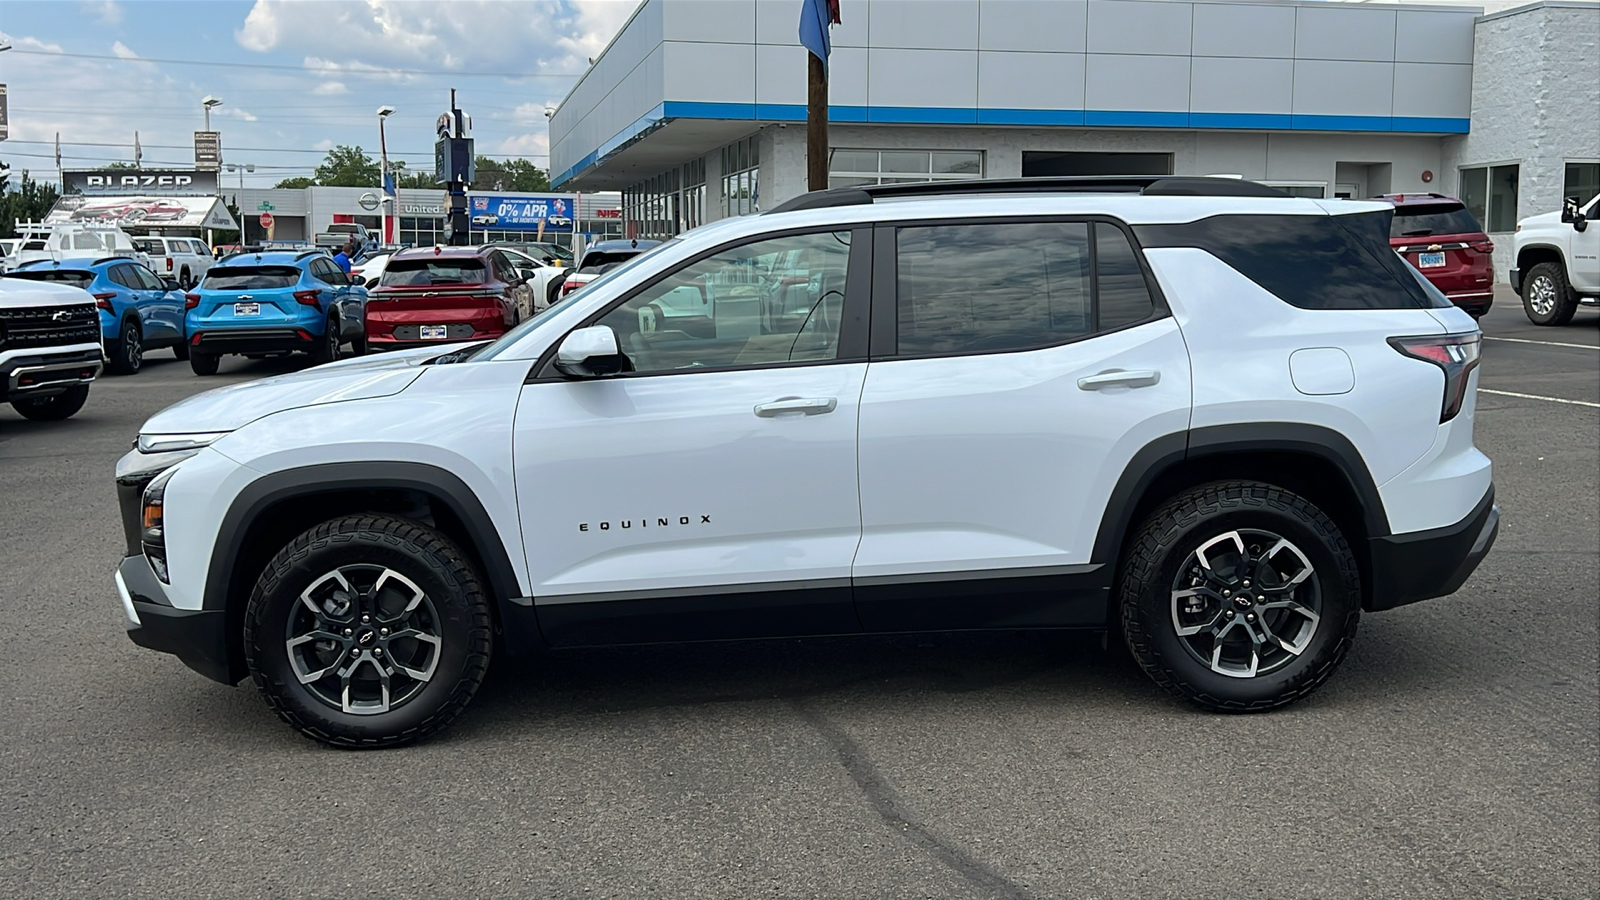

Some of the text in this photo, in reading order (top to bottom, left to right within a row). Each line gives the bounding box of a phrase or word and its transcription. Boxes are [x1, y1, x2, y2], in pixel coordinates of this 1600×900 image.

[87, 175, 193, 189] BLAZER
[405, 205, 440, 214] United
[498, 204, 518, 216] 0%
[522, 204, 548, 217] APR
[598, 210, 620, 218] NIS
[579, 514, 710, 532] EQUINOX
